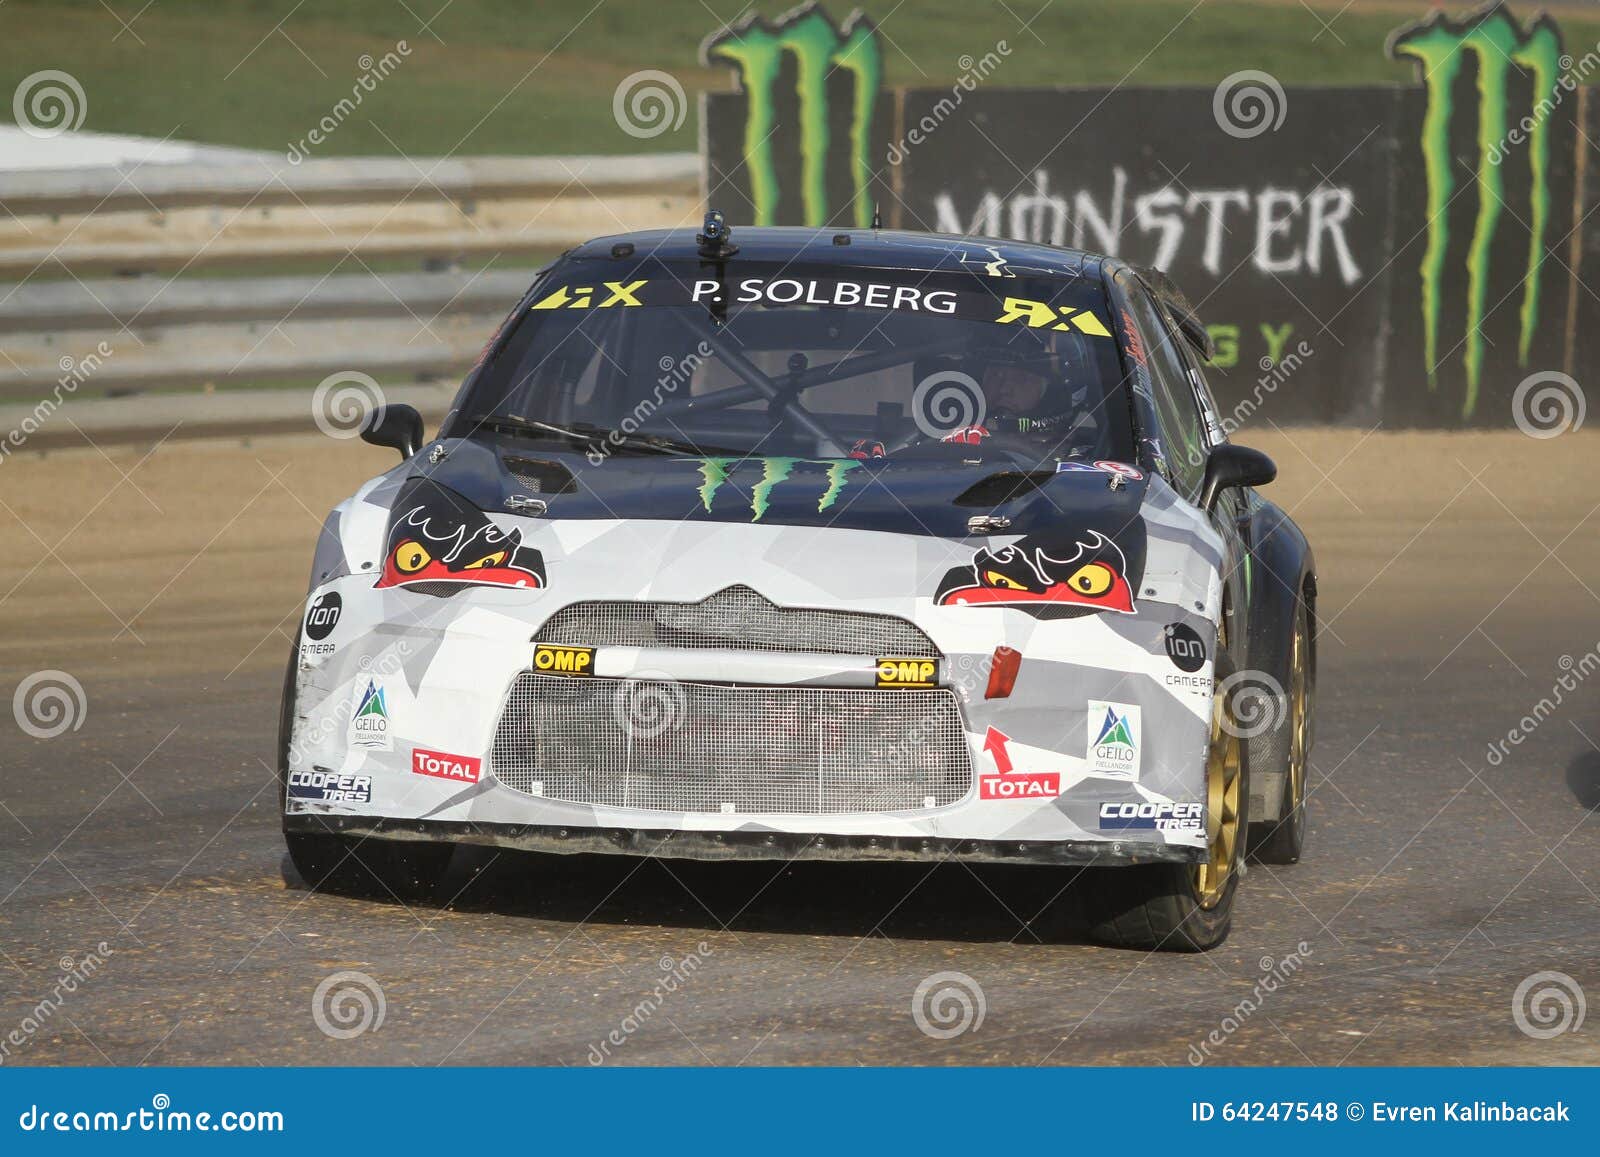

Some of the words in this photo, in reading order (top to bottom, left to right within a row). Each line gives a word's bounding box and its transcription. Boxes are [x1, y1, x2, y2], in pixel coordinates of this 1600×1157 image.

[934, 166, 1362, 286] MONSTER
[691, 280, 721, 302] P.
[737, 280, 958, 314] SOLBERG
[308, 595, 339, 626] ion
[301, 643, 336, 655] AMERA
[1167, 626, 1204, 658] ion
[535, 649, 590, 672] OMP
[878, 661, 935, 681] OMP
[1166, 675, 1212, 688] CAMERA
[355, 718, 387, 732] GEILO
[1096, 746, 1134, 762] GEILO
[415, 752, 476, 780] TOTAL
[289, 772, 371, 791] COOPER
[984, 778, 1057, 796] TOTAL
[322, 789, 369, 802] TIRES
[1100, 803, 1202, 819] COOPER
[1154, 818, 1201, 830] TIRES
